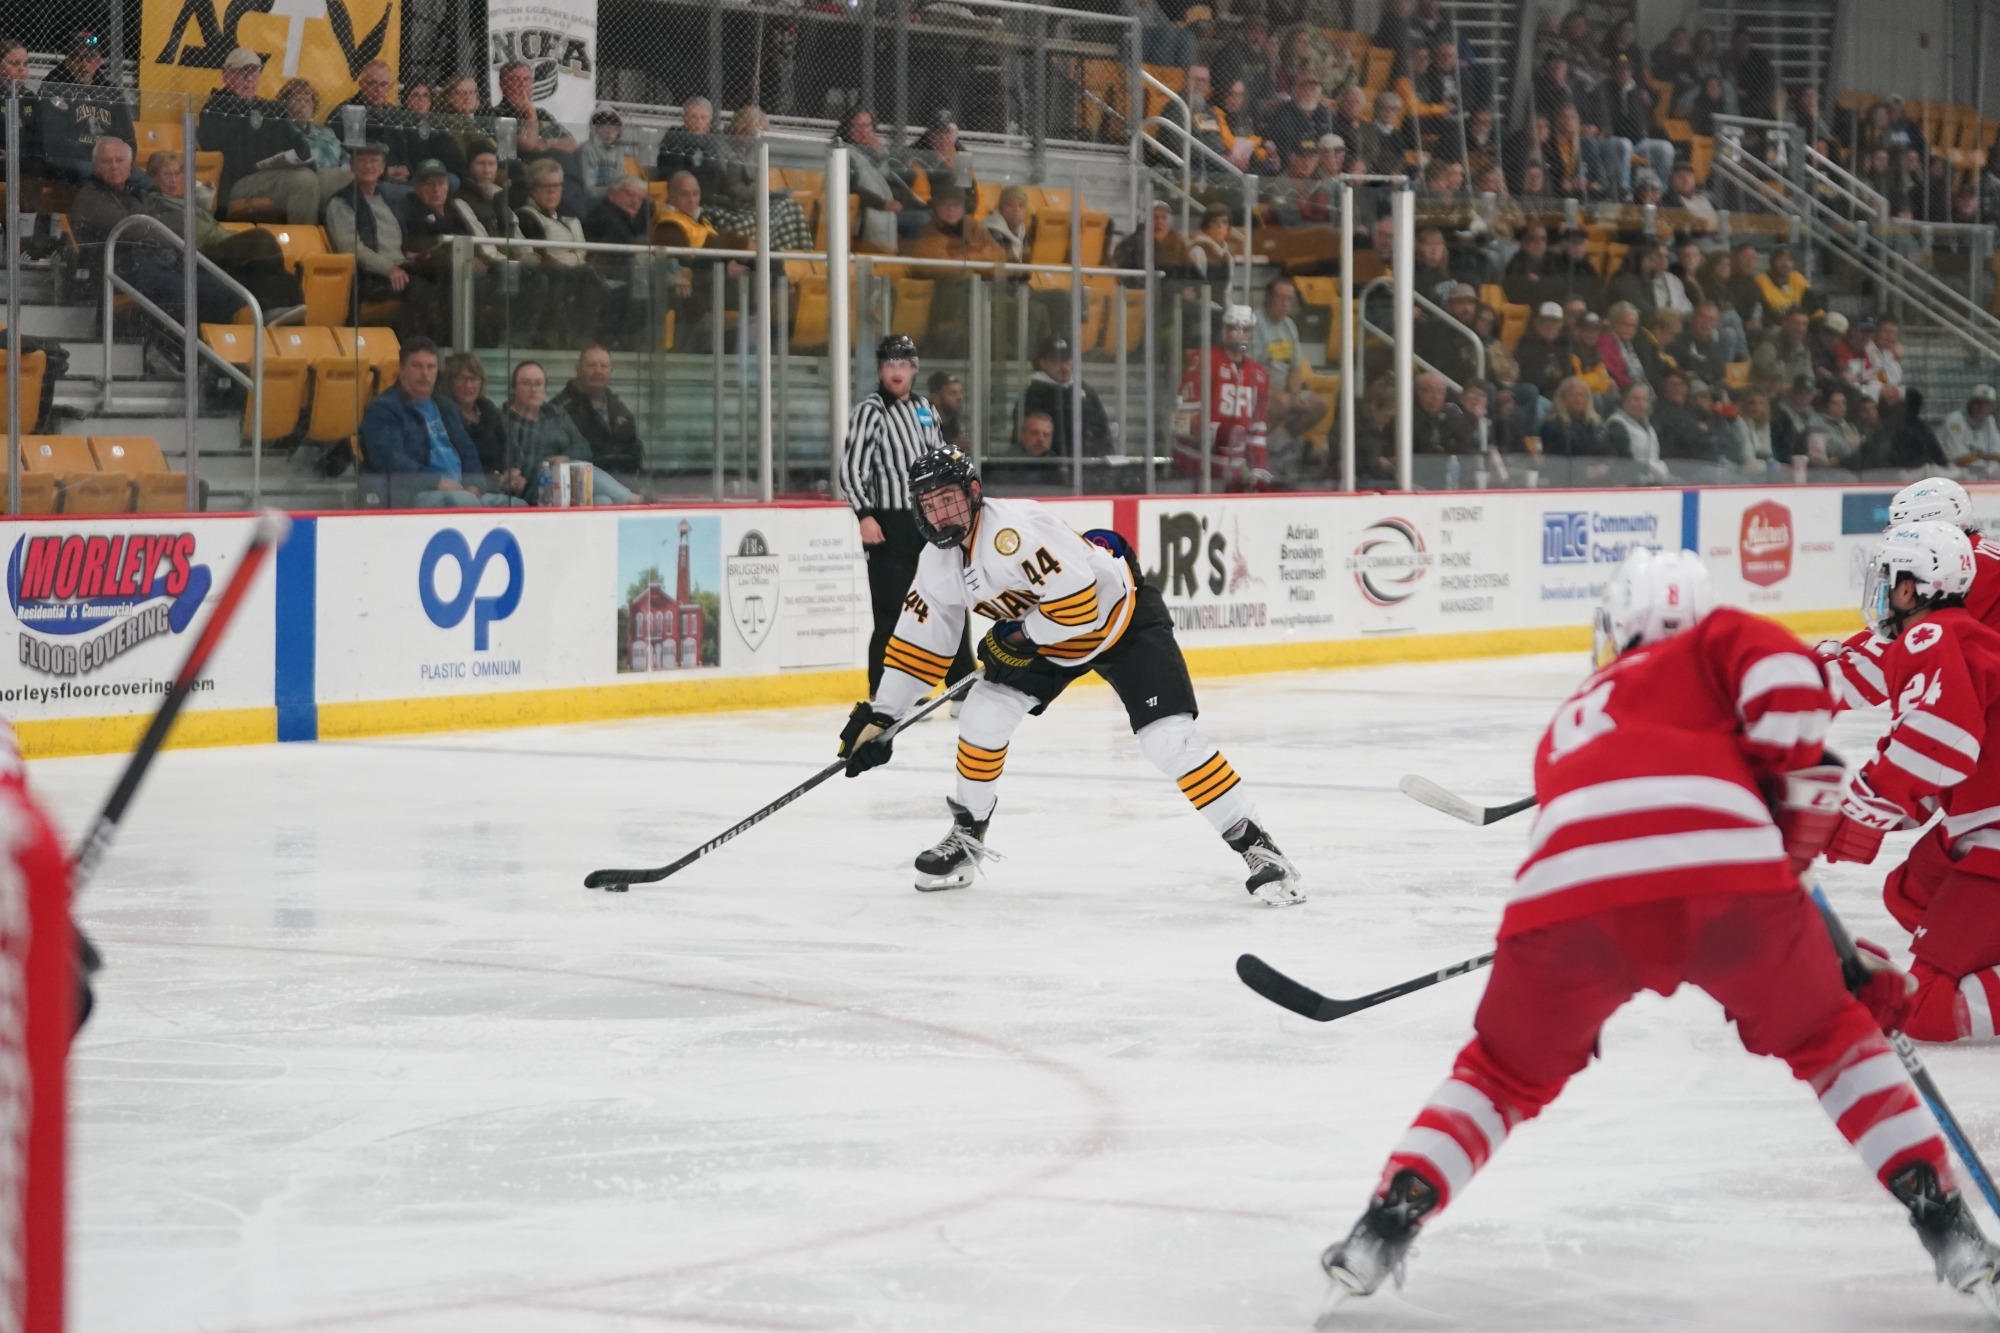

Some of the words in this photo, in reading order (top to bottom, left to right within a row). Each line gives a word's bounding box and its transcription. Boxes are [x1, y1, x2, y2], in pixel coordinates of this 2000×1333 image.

[1286, 524, 1319, 540] Adrian
[1593, 511, 1659, 539] Community
[1281, 543, 1324, 563] Brooklyn
[1960, 554, 1971, 571] 24
[19, 532, 196, 600] MORLEY'S
[729, 562, 779, 576] BRUGGEMAN
[1020, 547, 1064, 587] 44
[1279, 564, 1326, 581] Tecumseh
[1289, 586, 1316, 602] Milan
[18, 604, 67, 620] Residential
[71, 604, 77, 618] &
[82, 602, 133, 618] Commercial
[902, 589, 930, 624] 44
[19, 632, 76, 676] FLOOR
[79, 603, 169, 674] COVERING
[421, 662, 466, 680] PLASTIC
[472, 659, 521, 677] OMNIUM
